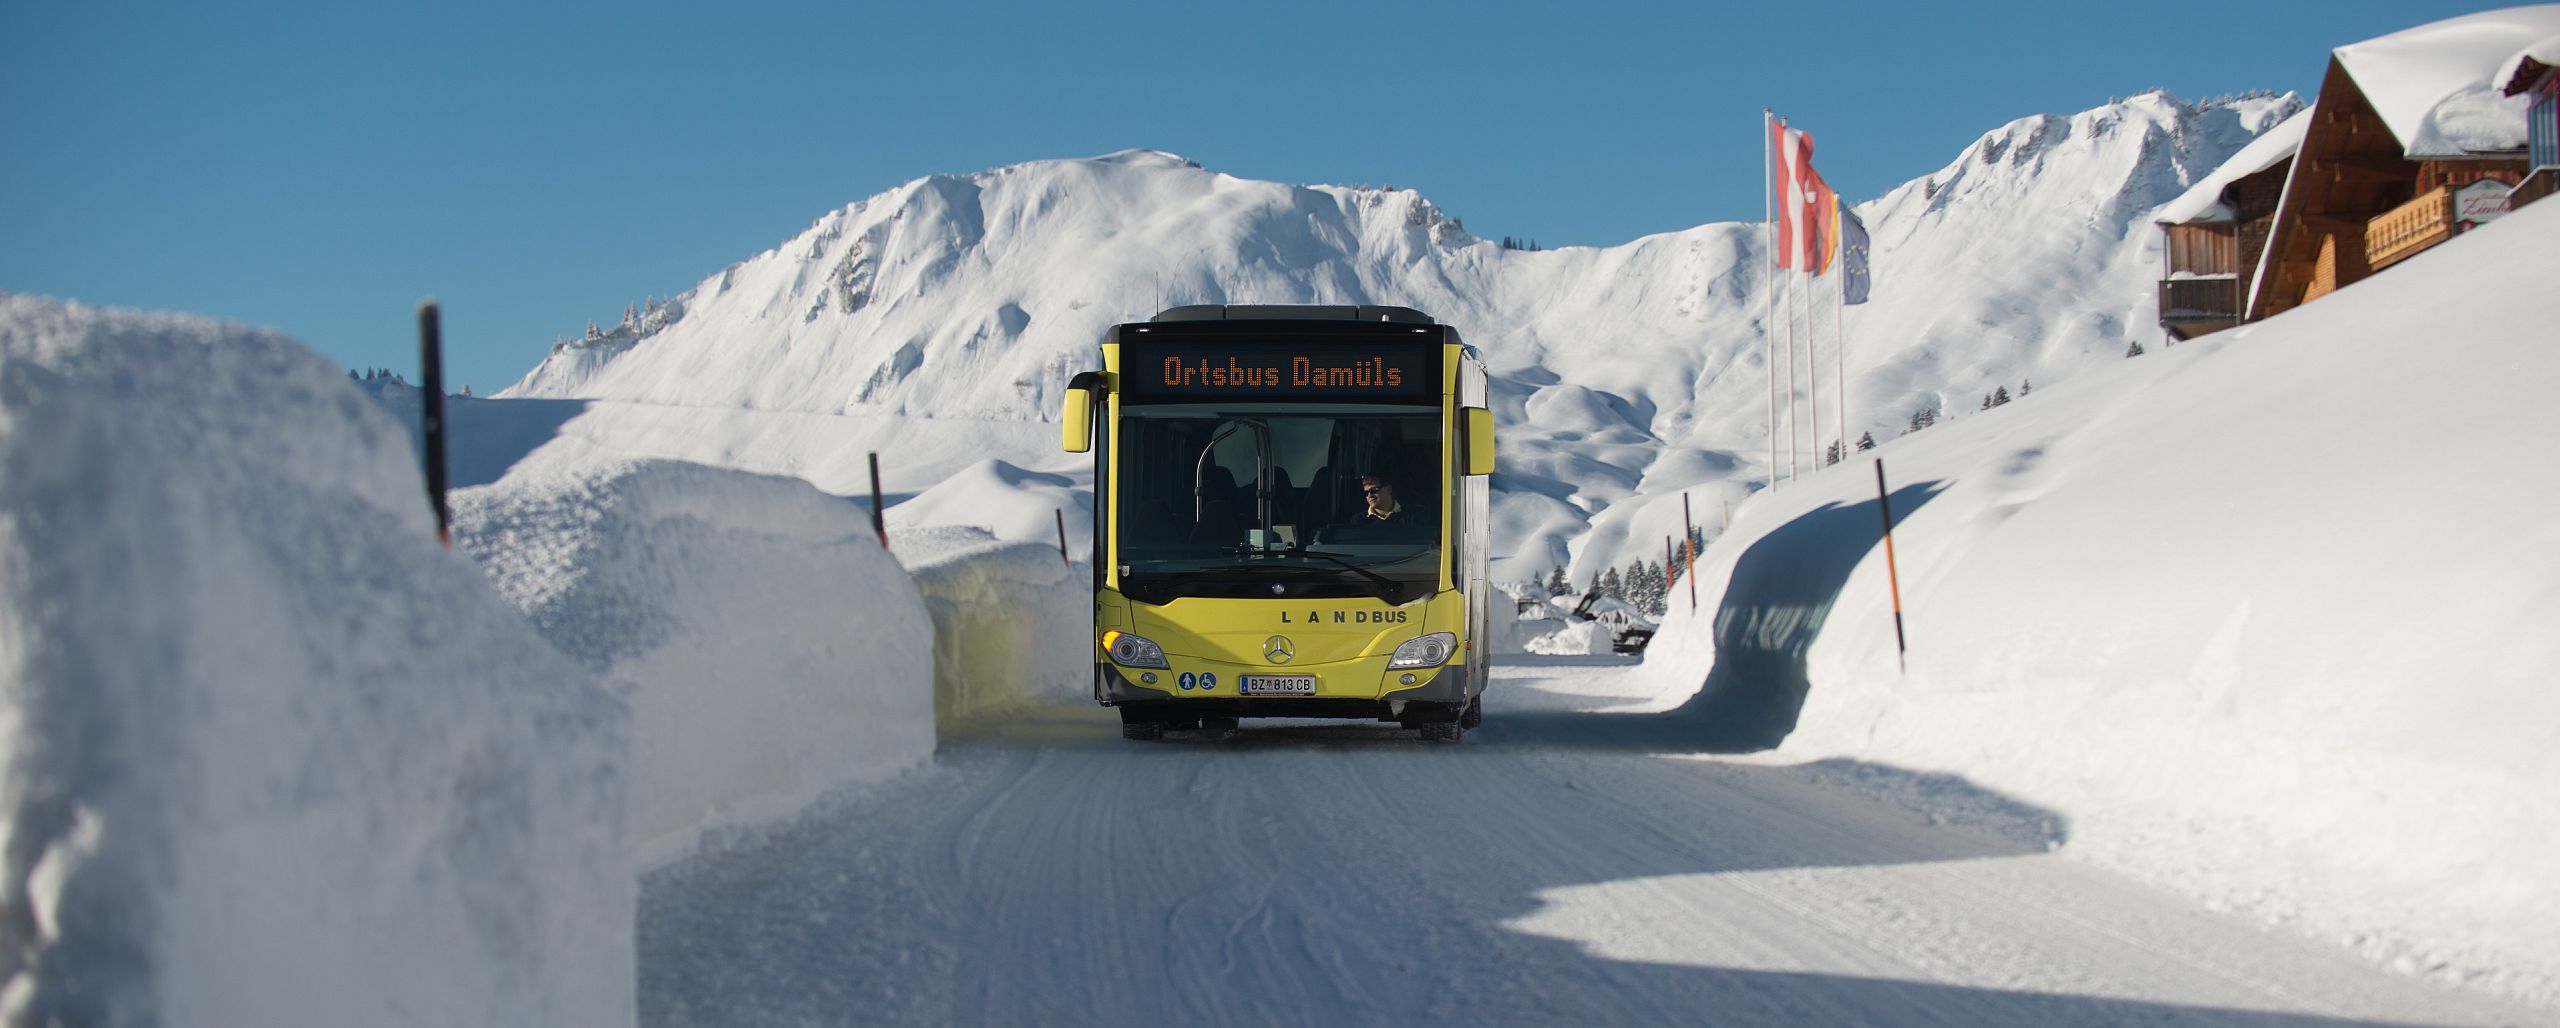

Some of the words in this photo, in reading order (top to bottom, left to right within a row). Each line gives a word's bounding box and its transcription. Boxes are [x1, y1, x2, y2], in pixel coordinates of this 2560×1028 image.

[1164, 356, 1279, 386] Ortsbus
[1293, 356, 1401, 386] Damüls
[1251, 679, 1265, 691] BZ
[1274, 679, 1293, 691] 813
[1296, 679, 1310, 691] CB
